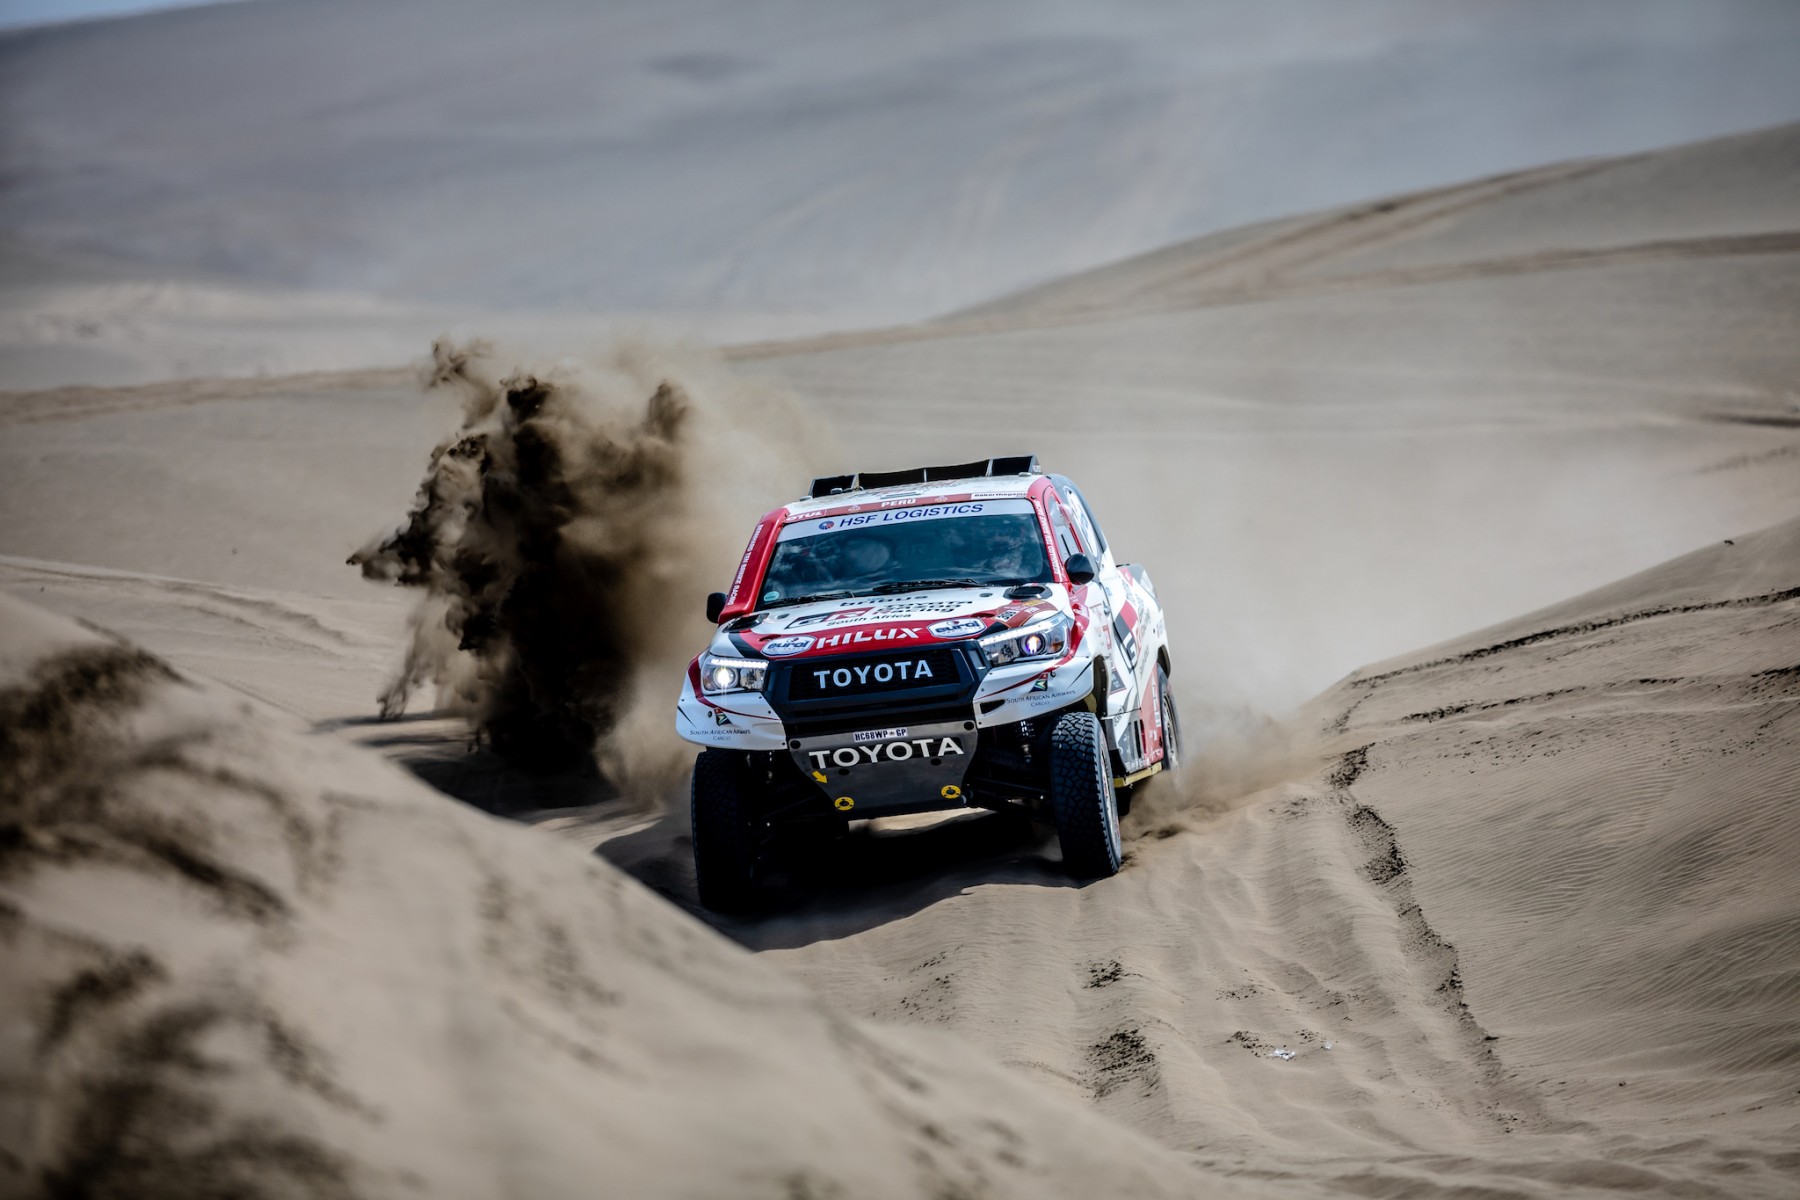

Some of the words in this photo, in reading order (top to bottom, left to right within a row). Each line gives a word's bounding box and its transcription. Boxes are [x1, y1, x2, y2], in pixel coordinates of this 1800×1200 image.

[881, 498, 916, 507] PERU
[839, 515, 877, 527] HSF
[883, 503, 983, 522] LOGISTICS
[826, 617, 868, 627] South
[935, 619, 980, 633] eurol
[767, 640, 811, 650] eurol
[816, 627, 923, 649] HILUX
[814, 660, 933, 689] TOYOTA
[896, 728, 907, 737] GP
[809, 737, 964, 770] TOYOTA
